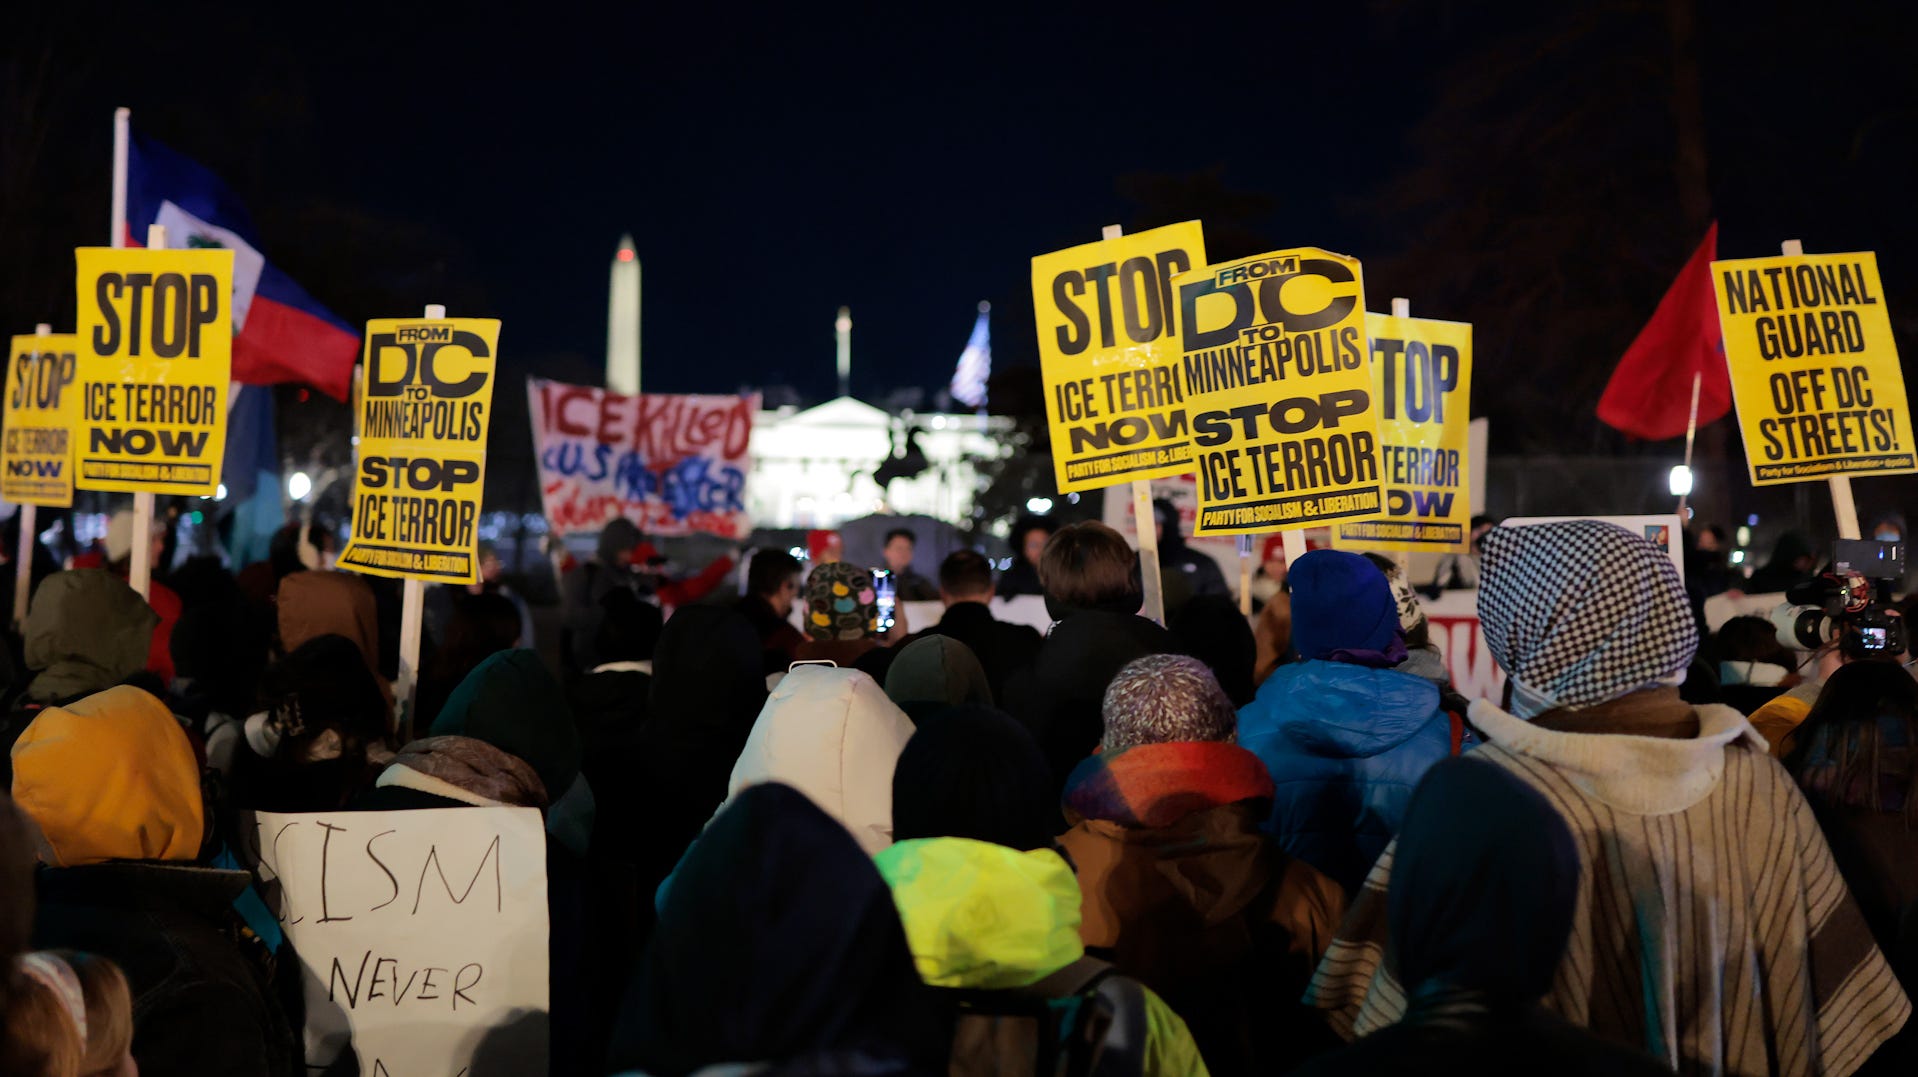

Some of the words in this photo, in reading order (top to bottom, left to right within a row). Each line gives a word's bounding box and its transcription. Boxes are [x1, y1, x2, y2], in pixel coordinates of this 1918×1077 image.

[1220, 258, 1296, 285] FROM
[1723, 263, 1877, 315] NATIONAL
[93, 272, 218, 358] STOP
[1052, 248, 1191, 356] STOP
[1180, 259, 1357, 353] DC
[399, 328, 449, 341] FROM
[1243, 325, 1280, 344] TO
[1755, 310, 1865, 361] GUARD
[13, 353, 76, 411] STOP
[368, 330, 490, 398] DC
[1184, 326, 1361, 396] MINNEAPOLIS
[1368, 337, 1459, 424] TOP
[84, 382, 117, 421] ICE
[122, 384, 216, 425] TERROR
[406, 388, 428, 400] TO
[541, 386, 628, 443] ICE
[1055, 378, 1097, 423] ICE
[1100, 363, 1184, 414] TERR
[1770, 368, 1826, 415] OFF
[1831, 365, 1874, 409] DC
[90, 428, 209, 457] NOW
[364, 400, 482, 441] MINNEAPOLIS
[1069, 409, 1189, 454] NOW
[1193, 389, 1370, 447] STOP
[1759, 408, 1900, 461] STREETS!
[7, 460, 62, 477] NOW
[361, 456, 479, 492] STOP
[1157, 450, 1170, 464] &
[1200, 448, 1247, 502] ICE
[1247, 430, 1378, 496] TERROR
[1382, 445, 1460, 487] TERROR
[356, 494, 386, 539] ICE
[392, 496, 475, 547] TERROR
[1203, 509, 1235, 526] PARTY
[1235, 506, 1254, 524] FOR
[1303, 500, 1318, 516] &
[1319, 492, 1379, 514] LIBERATION
[1388, 489, 1455, 518] OW
[413, 553, 424, 570] &
[330, 950, 483, 1011] NEVER
